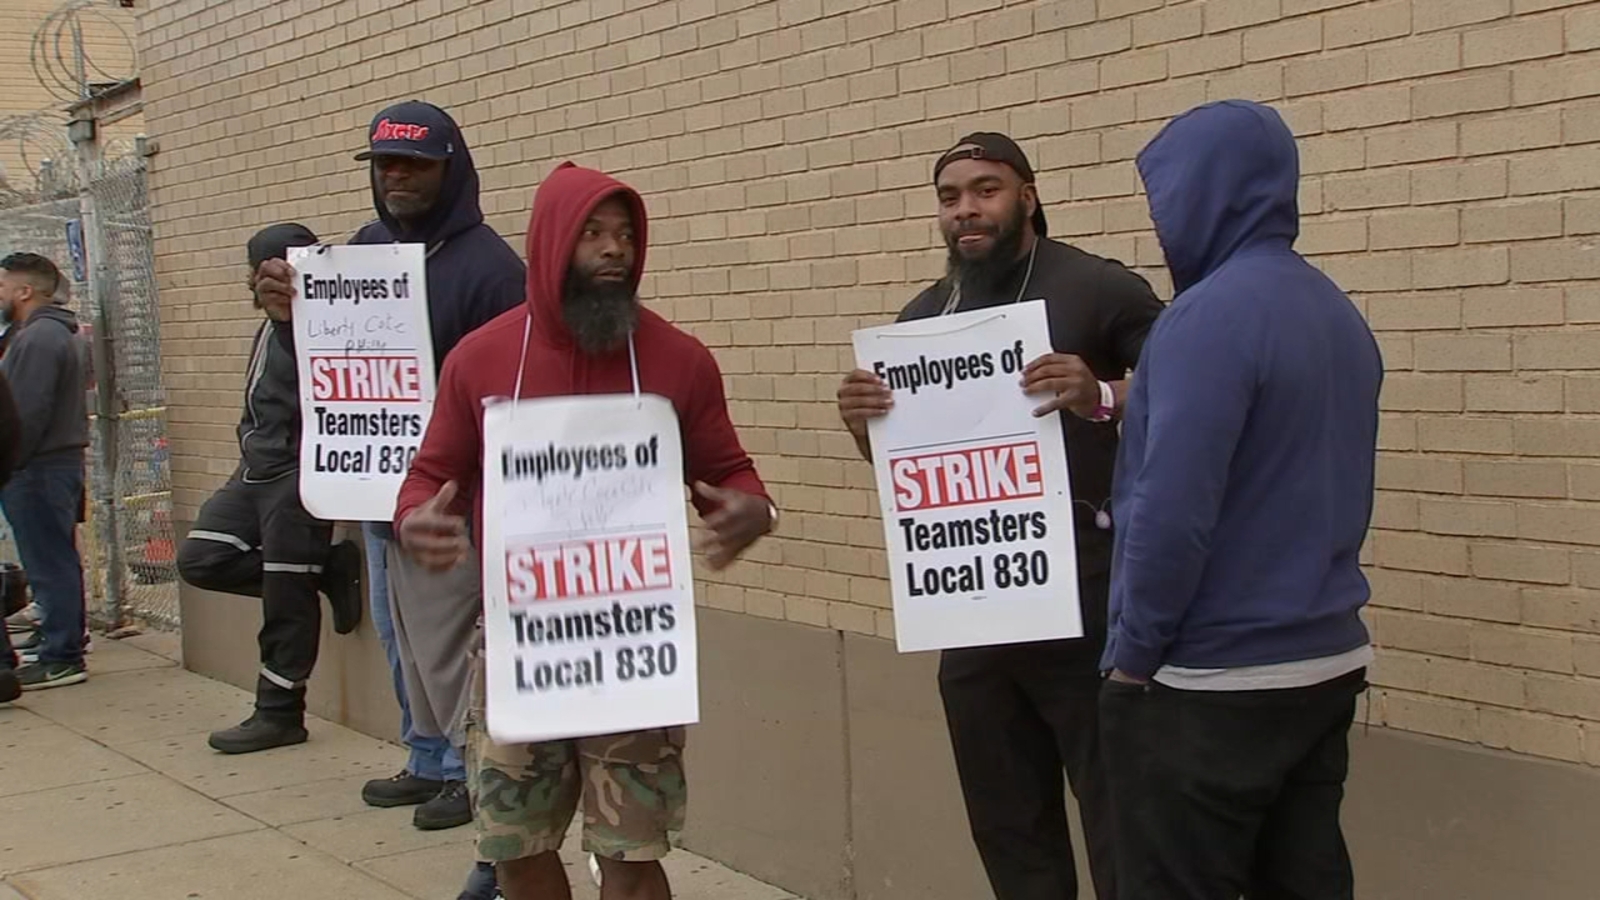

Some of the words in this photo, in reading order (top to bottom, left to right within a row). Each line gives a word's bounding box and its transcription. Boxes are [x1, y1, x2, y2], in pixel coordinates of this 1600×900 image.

[304, 273, 388, 305] Employees
[393, 272, 409, 300] of
[313, 357, 420, 401] STRIKE
[873, 352, 993, 394] Employees
[1002, 340, 1024, 374] of
[315, 406, 421, 437] Teamsters
[315, 444, 372, 473] Local
[502, 442, 627, 483] Employees
[635, 434, 659, 468] of
[890, 442, 1043, 512] STRIKE
[899, 509, 1047, 552] Teamsters
[506, 535, 672, 604] STRIKE
[906, 555, 984, 597] Local
[993, 550, 1049, 590] 830
[510, 601, 676, 646] Teamsters
[514, 648, 603, 694] Local
[615, 642, 677, 682] 830
